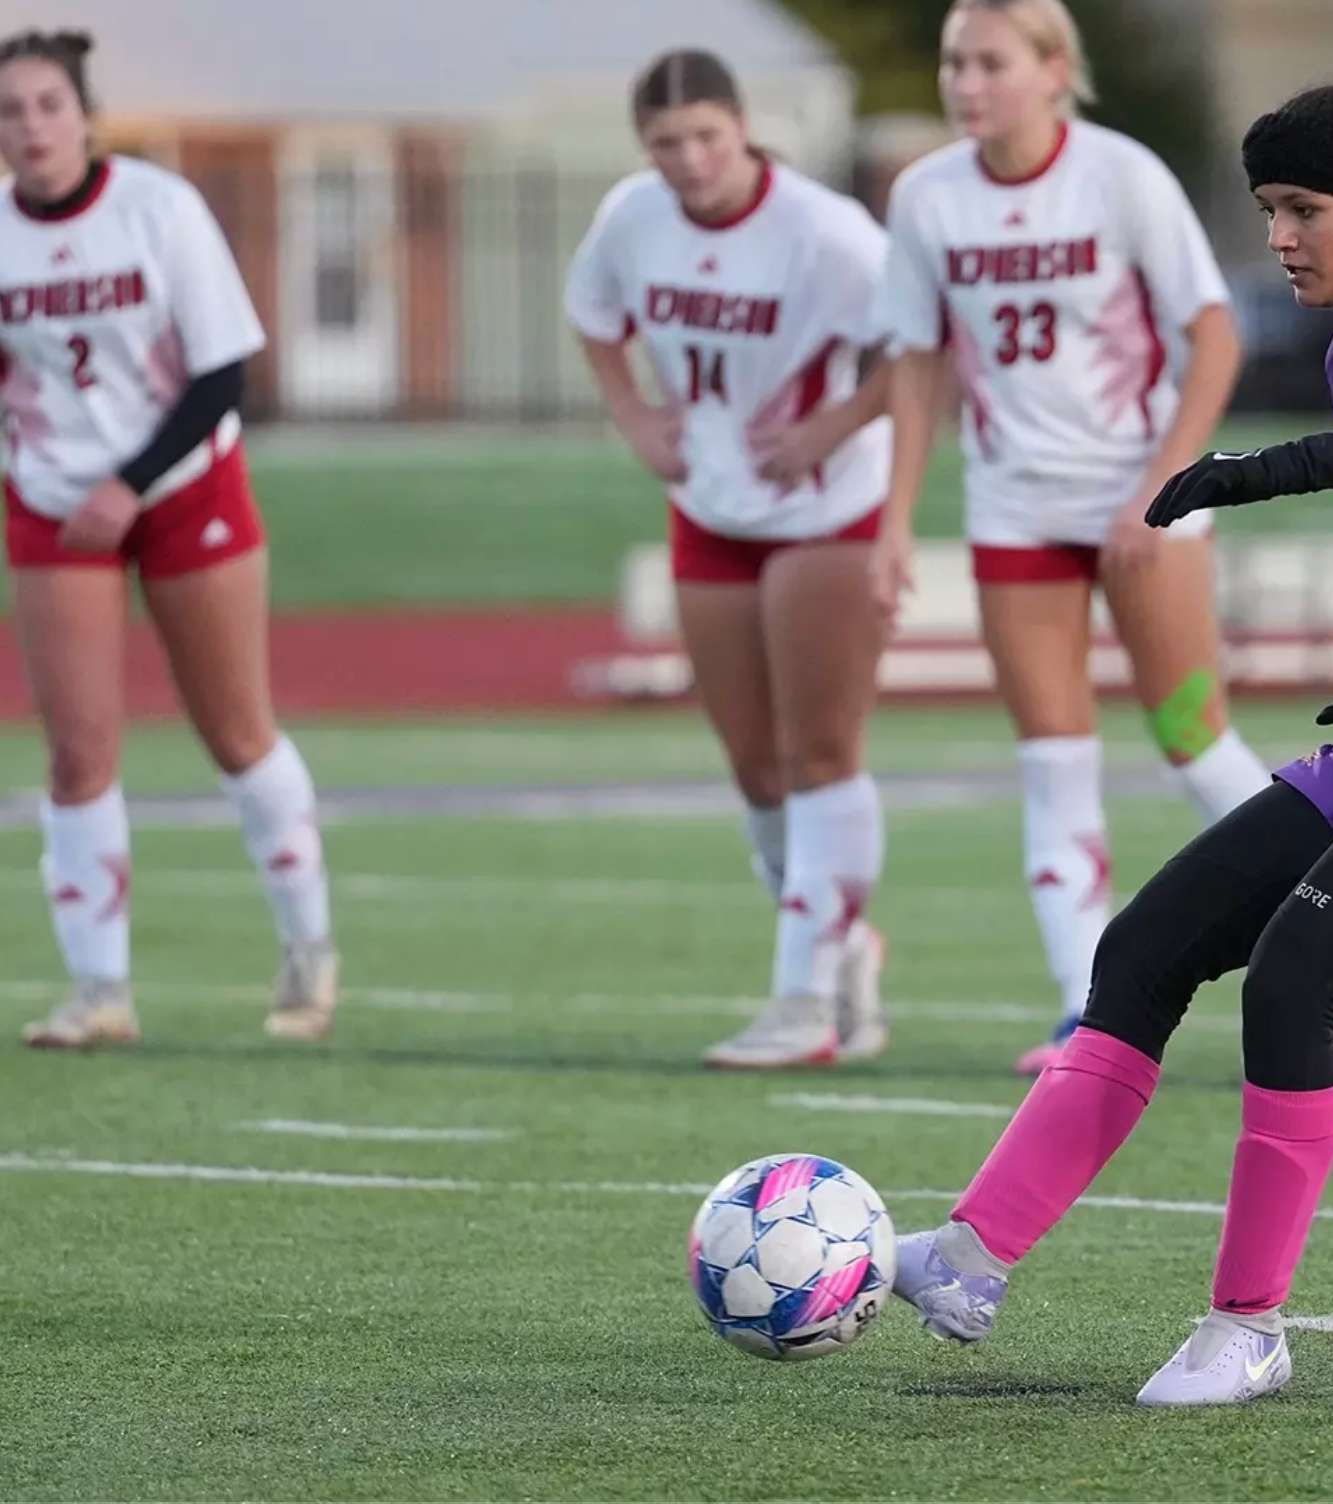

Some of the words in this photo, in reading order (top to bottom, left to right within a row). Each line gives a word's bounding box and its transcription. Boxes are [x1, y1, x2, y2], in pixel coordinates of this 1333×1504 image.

[67, 332, 99, 390] 2
[994, 301, 1057, 367] 33
[685, 345, 728, 404] 14
[1294, 882, 1332, 909] GORE
